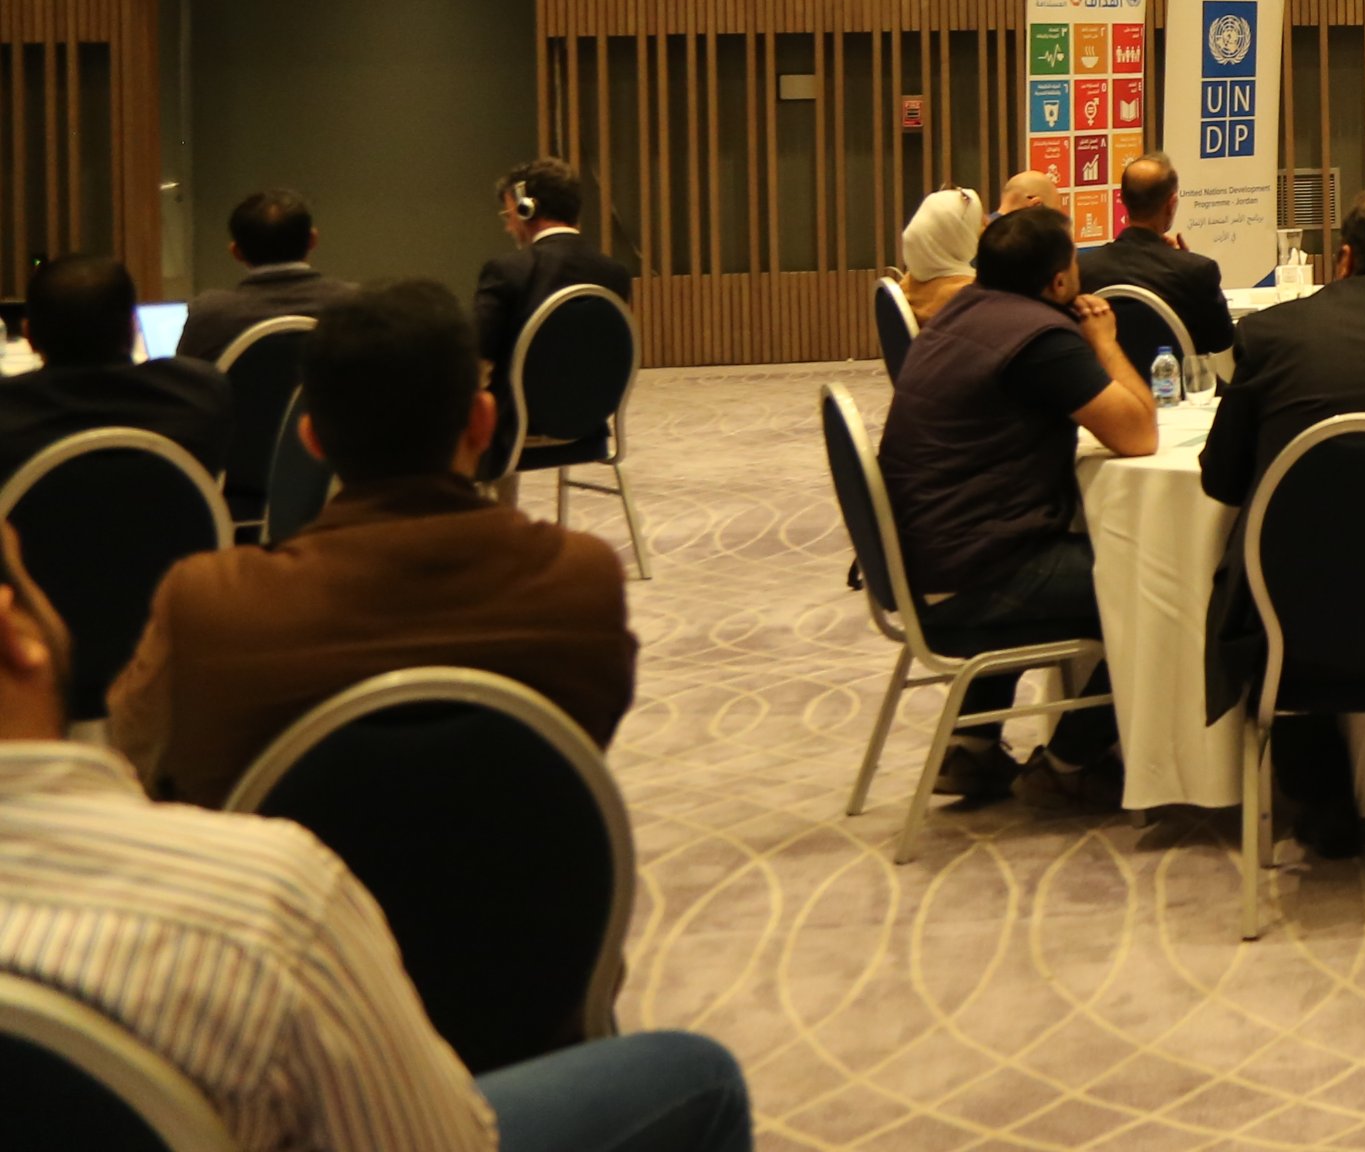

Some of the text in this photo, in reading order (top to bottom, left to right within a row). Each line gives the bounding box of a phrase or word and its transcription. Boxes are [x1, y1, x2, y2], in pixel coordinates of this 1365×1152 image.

[1179, 185, 1271, 198] United Nations Development
[1194, 197, 1259, 209] Programme Jordan
